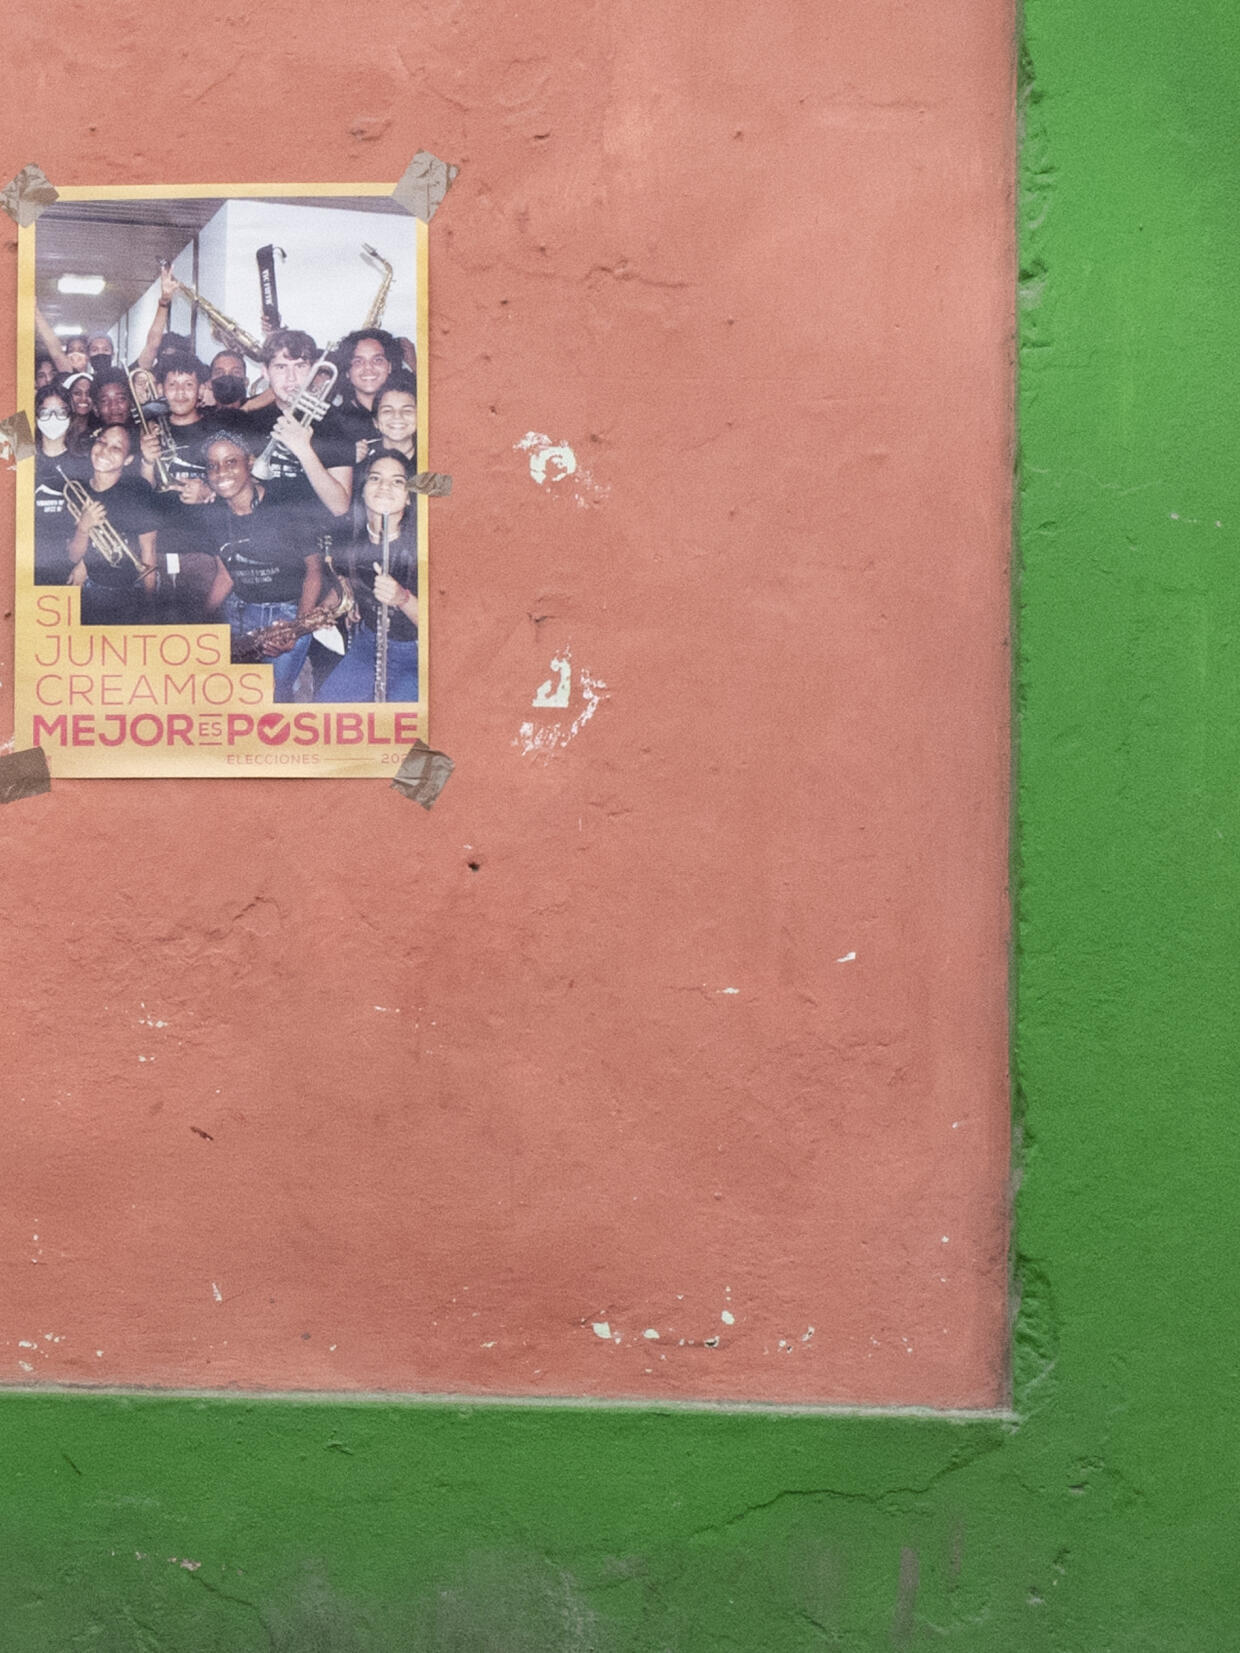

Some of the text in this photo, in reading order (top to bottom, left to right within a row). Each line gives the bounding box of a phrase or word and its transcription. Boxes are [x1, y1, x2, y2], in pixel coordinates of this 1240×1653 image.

[36, 594, 71, 627] SI
[35, 633, 221, 667] JUNTOS
[36, 672, 264, 706] CREAMOS
[33, 711, 419, 747] MEJOR ES POSIBLE
[227, 753, 320, 765] ELECCIONES
